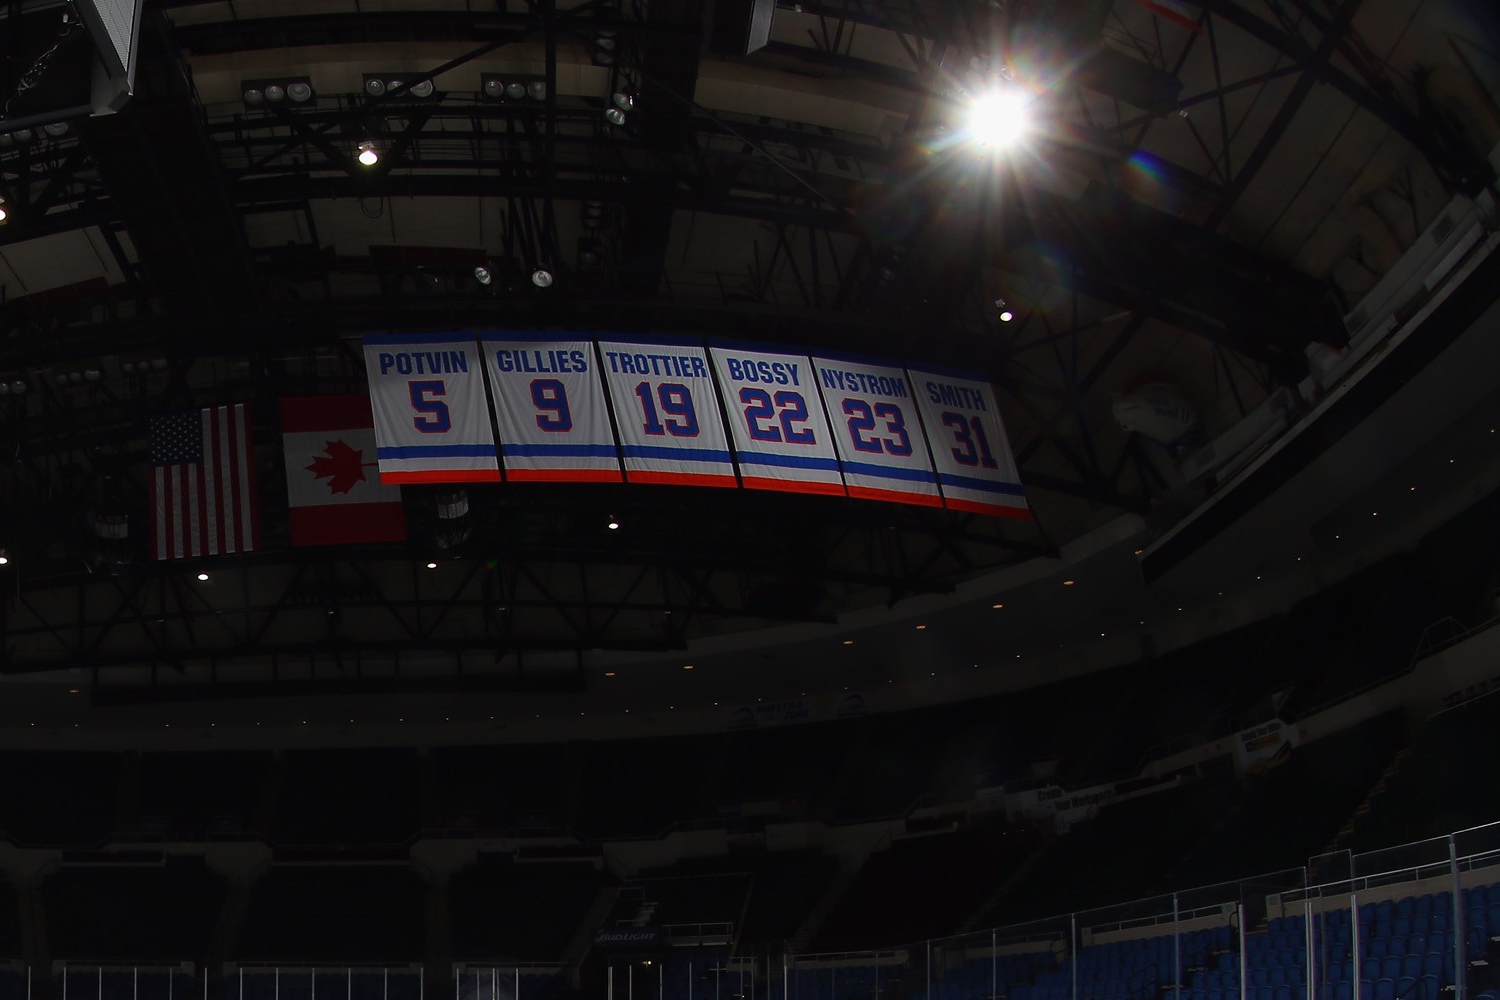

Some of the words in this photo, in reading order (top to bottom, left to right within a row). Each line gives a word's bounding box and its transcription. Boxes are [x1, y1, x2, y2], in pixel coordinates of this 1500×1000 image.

[379, 350, 468, 375] POTVIN
[496, 350, 587, 373] GILLIES
[606, 352, 707, 378] TROTTIER
[726, 357, 799, 386] BOSSY
[821, 368, 908, 399] NYSTROM
[926, 381, 988, 412] SMITH
[408, 380, 451, 434] 5
[529, 378, 573, 432] 9
[635, 381, 700, 437] 19
[739, 387, 816, 445] 22
[842, 398, 913, 457] 23
[941, 411, 999, 470] 31
[599, 933, 623, 941] BUD
[623, 933, 656, 941] LIGHT
